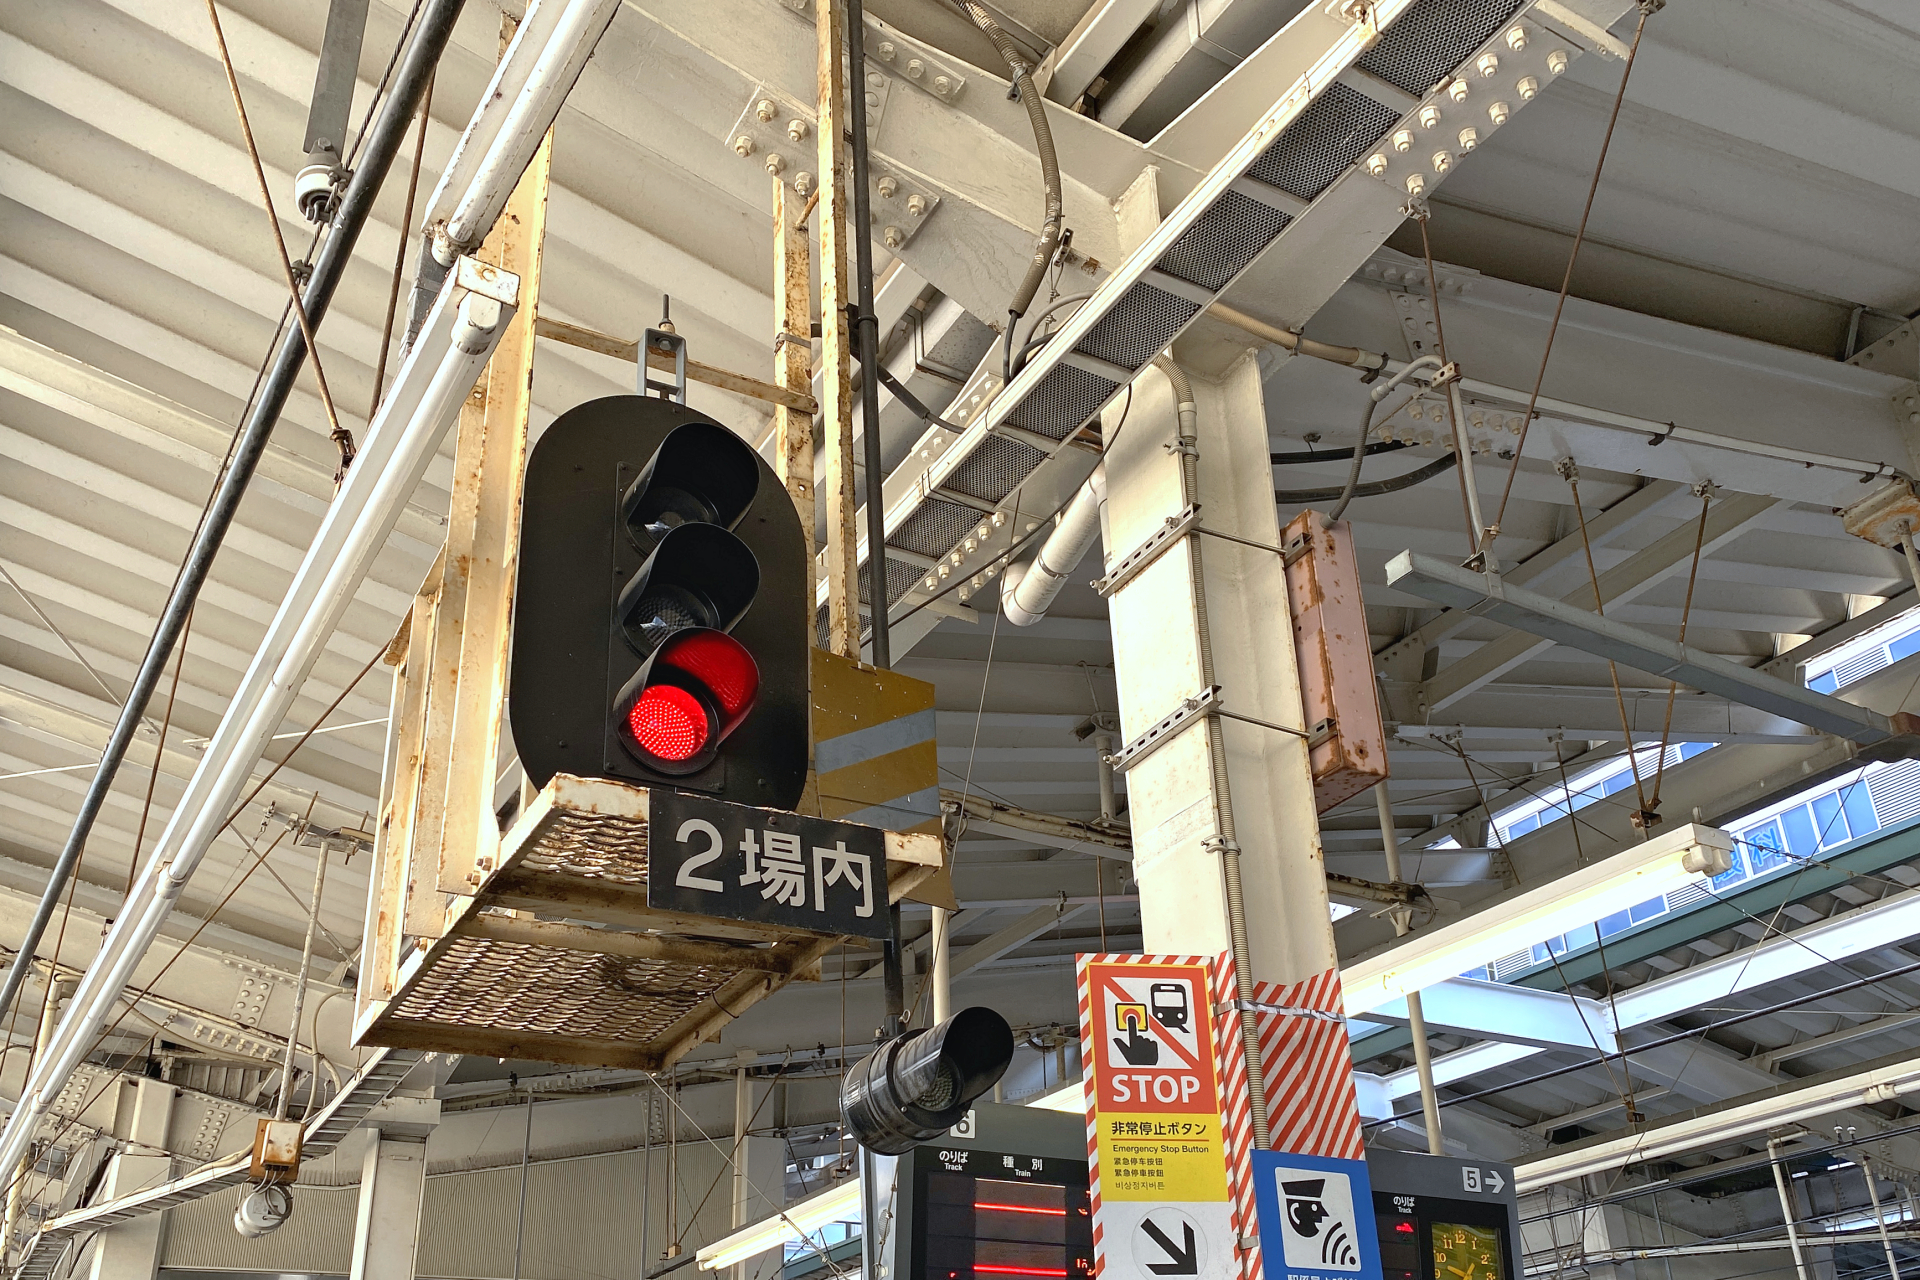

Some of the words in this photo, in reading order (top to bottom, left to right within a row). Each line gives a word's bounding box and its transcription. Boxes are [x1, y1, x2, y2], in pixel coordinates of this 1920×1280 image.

[675, 818, 874, 918] 2場内
[1111, 1074, 1200, 1103] STOP
[1111, 1121, 1207, 1136] 非常停止ボタン
[1112, 1144, 1159, 1155] Emergency
[1160, 1145, 1180, 1154] Stop
[1181, 1145, 1209, 1153] Button
[939, 1150, 969, 1163] のりば
[944, 1162, 963, 1171] Track
[1014, 1168, 1031, 1177] Train
[1466, 1170, 1478, 1189] 5
[1115, 1181, 1165, 1190] 비상정지버튼
[1393, 1196, 1415, 1207] のりば
[1397, 1206, 1412, 1214] Track
[1455, 1233, 1466, 1244] 12
[1443, 1239, 1454, 1250] 11
[1471, 1240, 1477, 1250] 1
[1436, 1252, 1447, 1263] 10
[1481, 1254, 1488, 1265] 2
[1435, 1268, 1441, 1279] 9
[1486, 1272, 1493, 1280] 3
